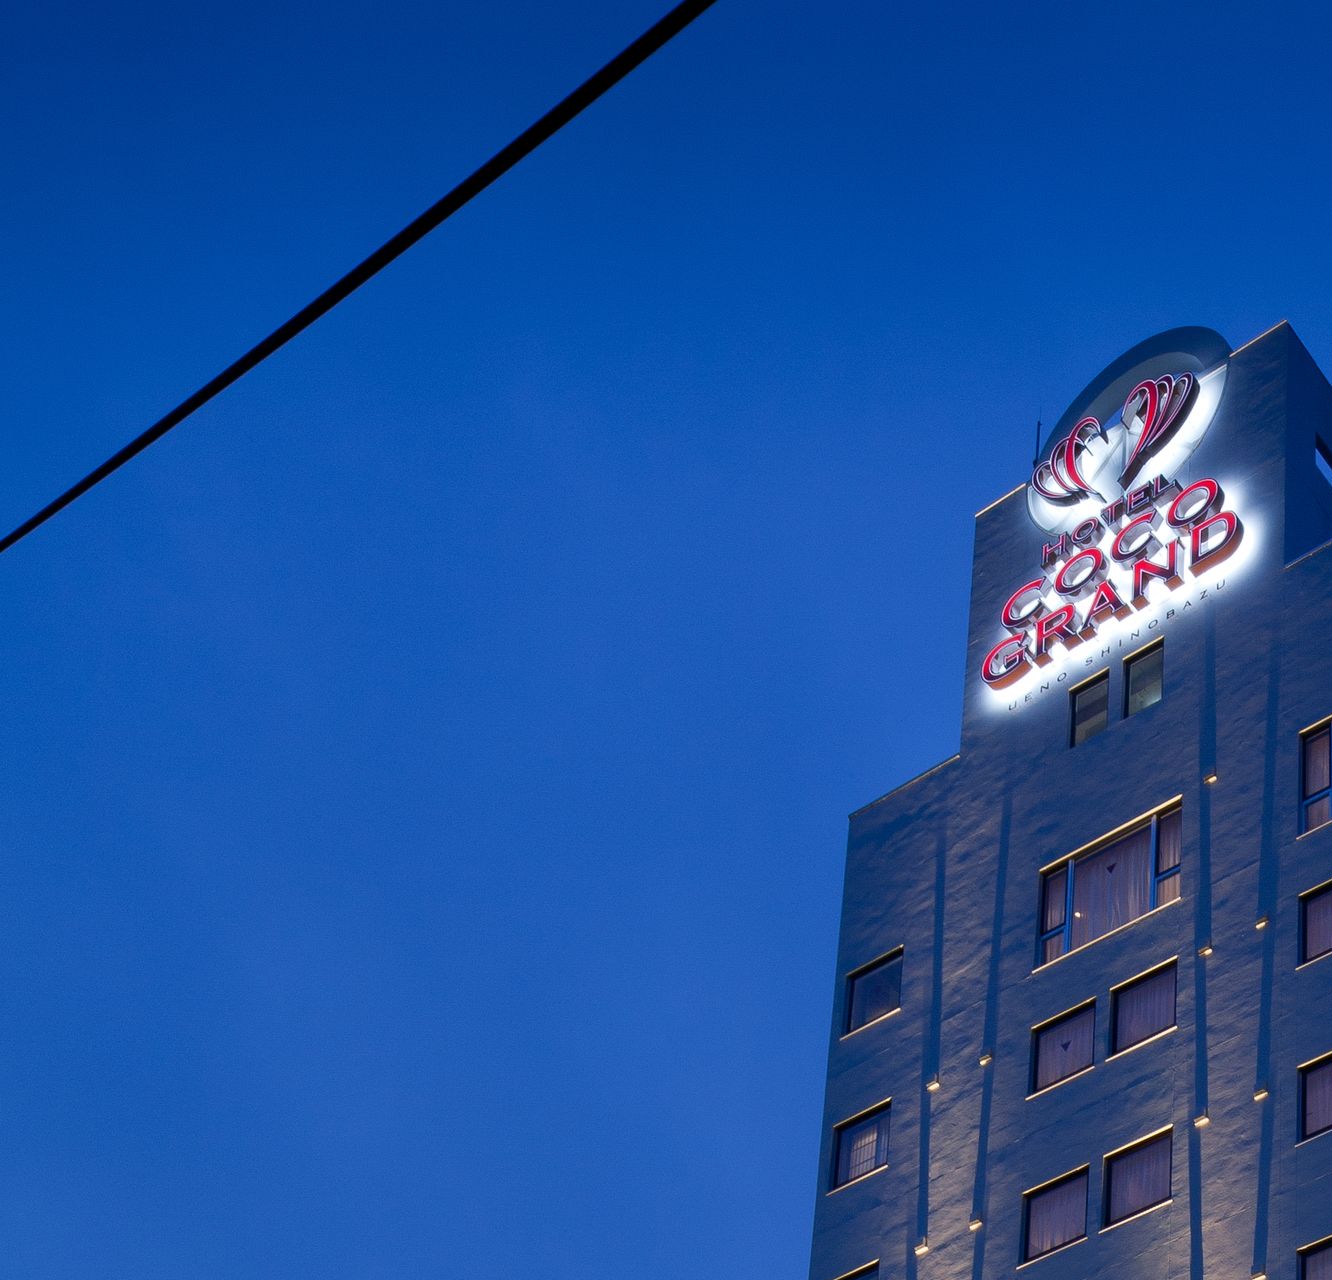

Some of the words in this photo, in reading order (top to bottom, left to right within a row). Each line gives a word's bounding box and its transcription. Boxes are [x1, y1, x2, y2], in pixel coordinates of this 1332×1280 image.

[1001, 478, 1222, 630] COCO
[1040, 474, 1180, 569] HOTEL
[981, 511, 1242, 687] GRAND
[1008, 672, 1067, 711] UENO
[1085, 579, 1227, 666] SHINOBAZU
